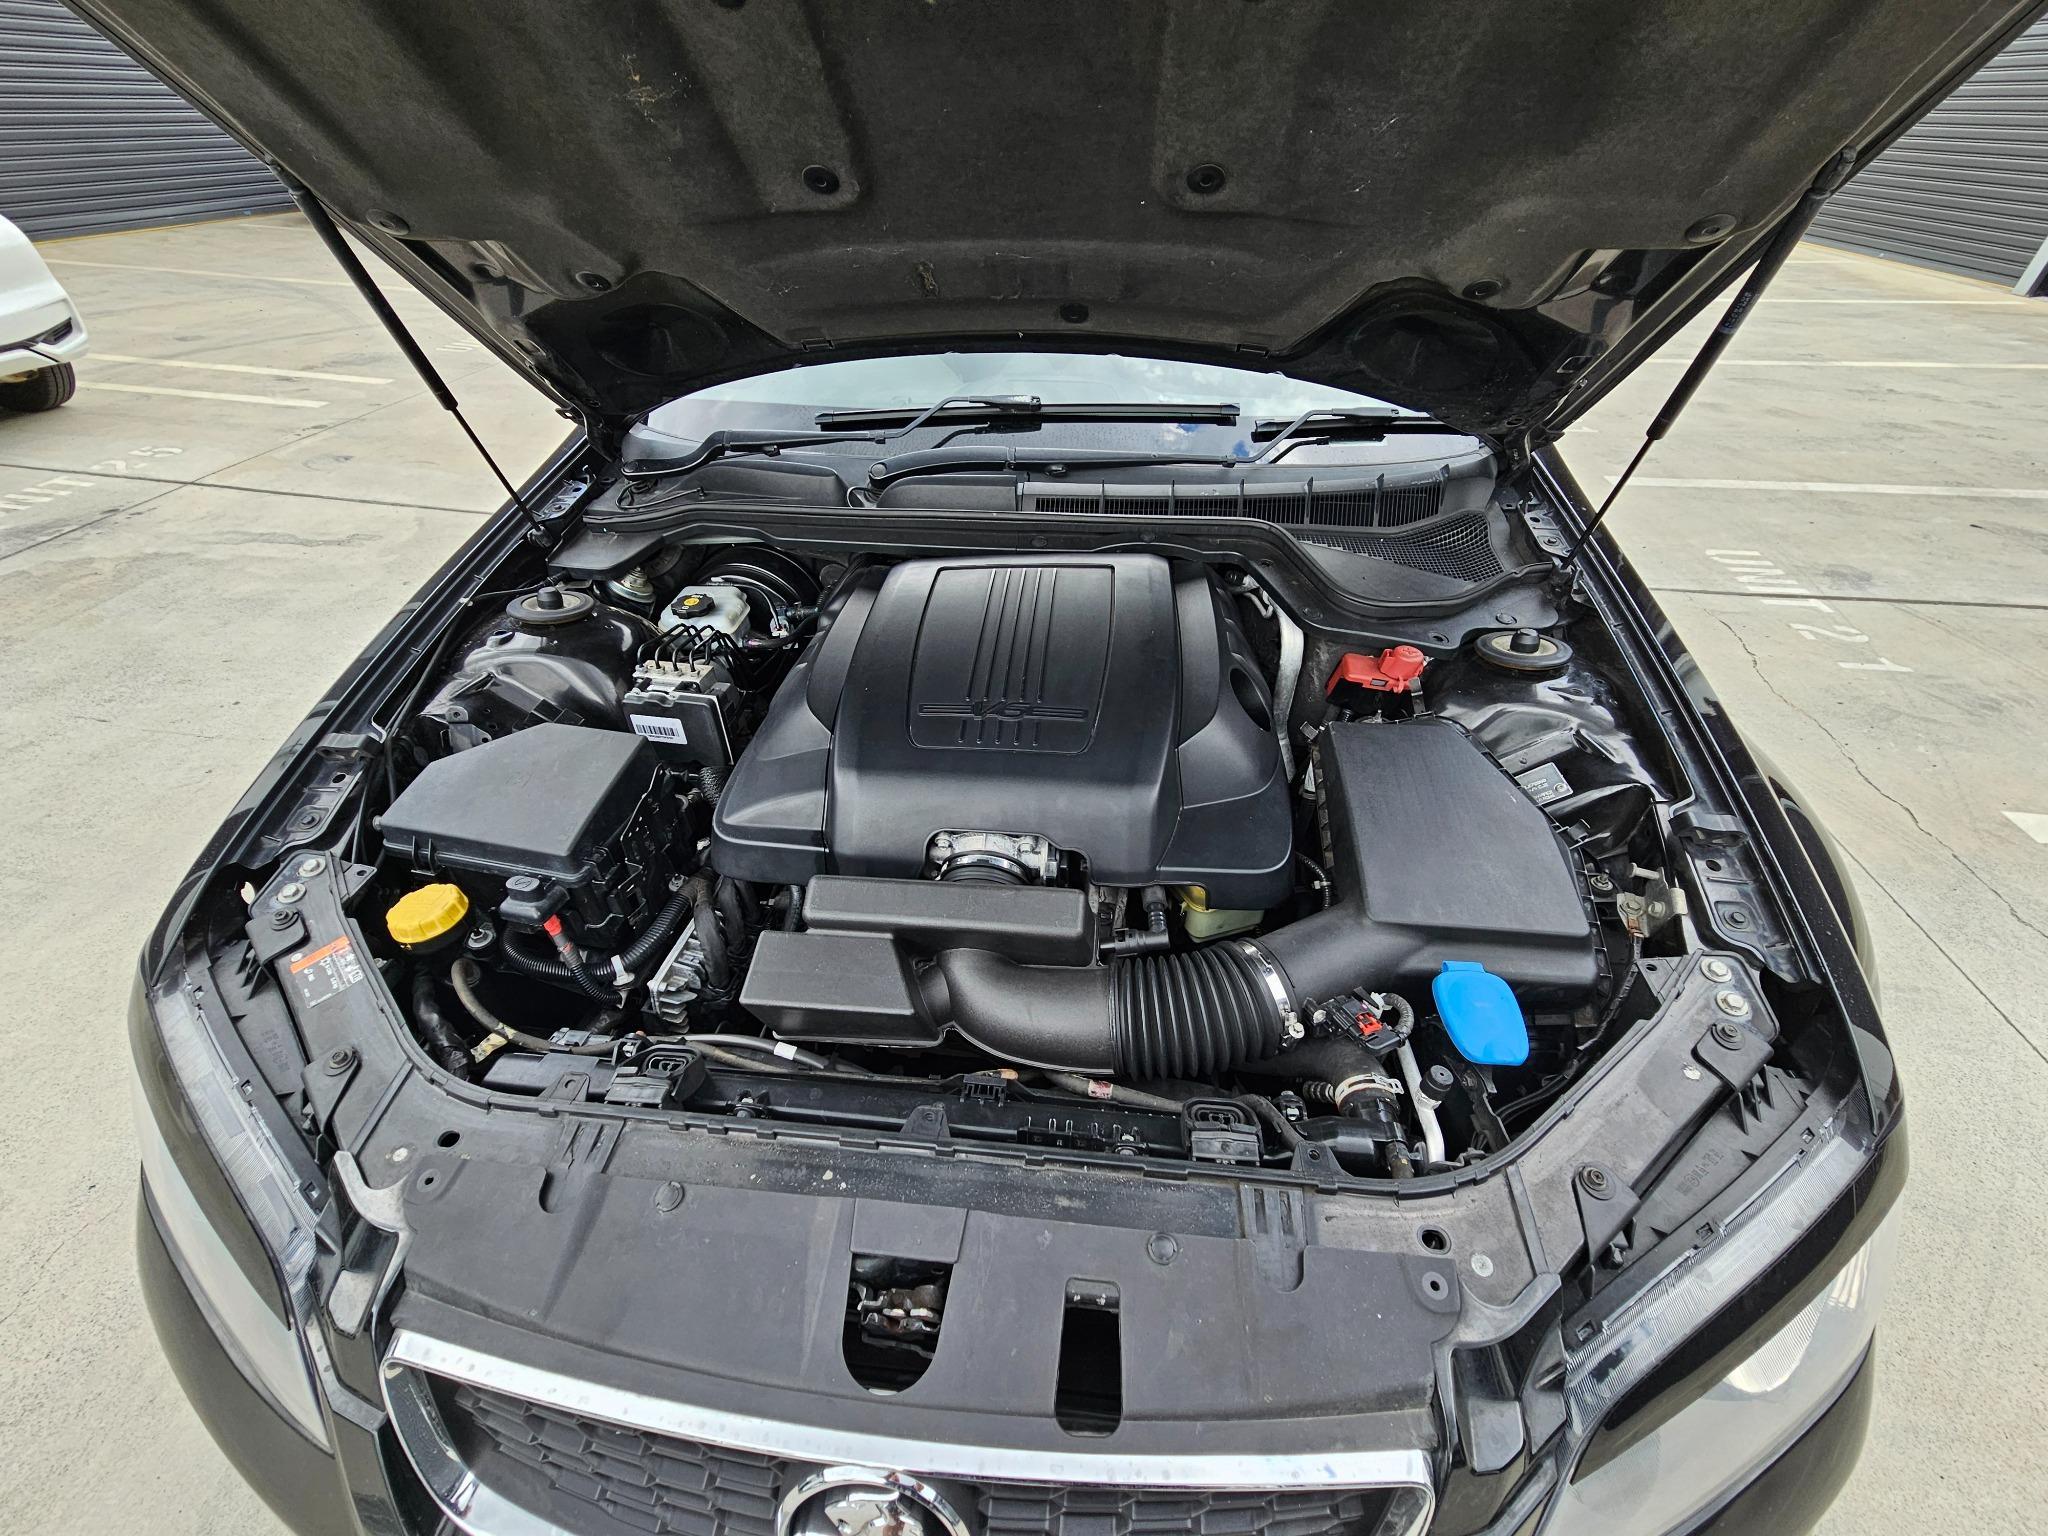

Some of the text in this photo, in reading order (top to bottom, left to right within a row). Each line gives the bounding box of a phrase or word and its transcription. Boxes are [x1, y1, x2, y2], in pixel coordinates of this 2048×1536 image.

[0, 475, 96, 517] NIT
[1704, 549, 1915, 673] UNIT 21
[972, 700, 1032, 721] V6
